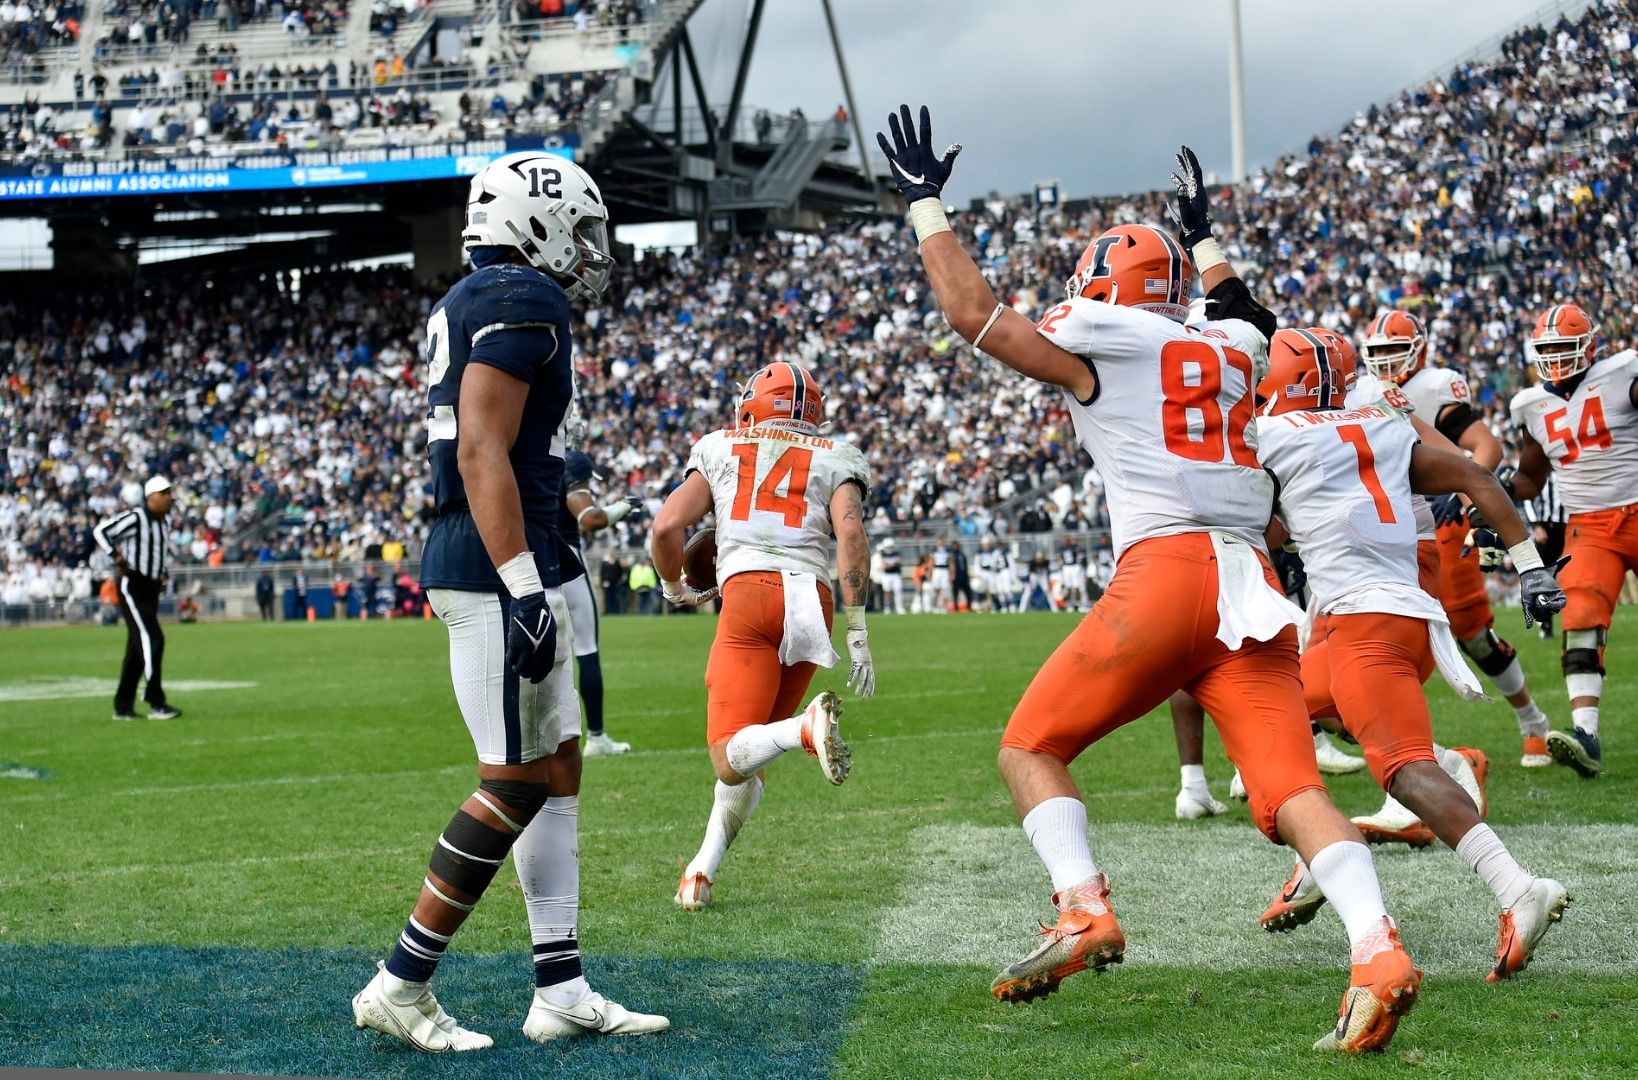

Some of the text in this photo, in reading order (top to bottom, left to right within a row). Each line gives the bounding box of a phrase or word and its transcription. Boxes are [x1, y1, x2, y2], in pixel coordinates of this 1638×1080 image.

[0, 172, 229, 196] STATE ALUMNI ASSOCIATION
[529, 168, 562, 199] 12
[806, 401, 816, 416] 14
[1161, 341, 1263, 469] 82
[724, 428, 834, 450] WASHINGTON
[1544, 396, 1613, 466] 54
[730, 443, 813, 529] 14
[1336, 424, 1396, 523] 1
